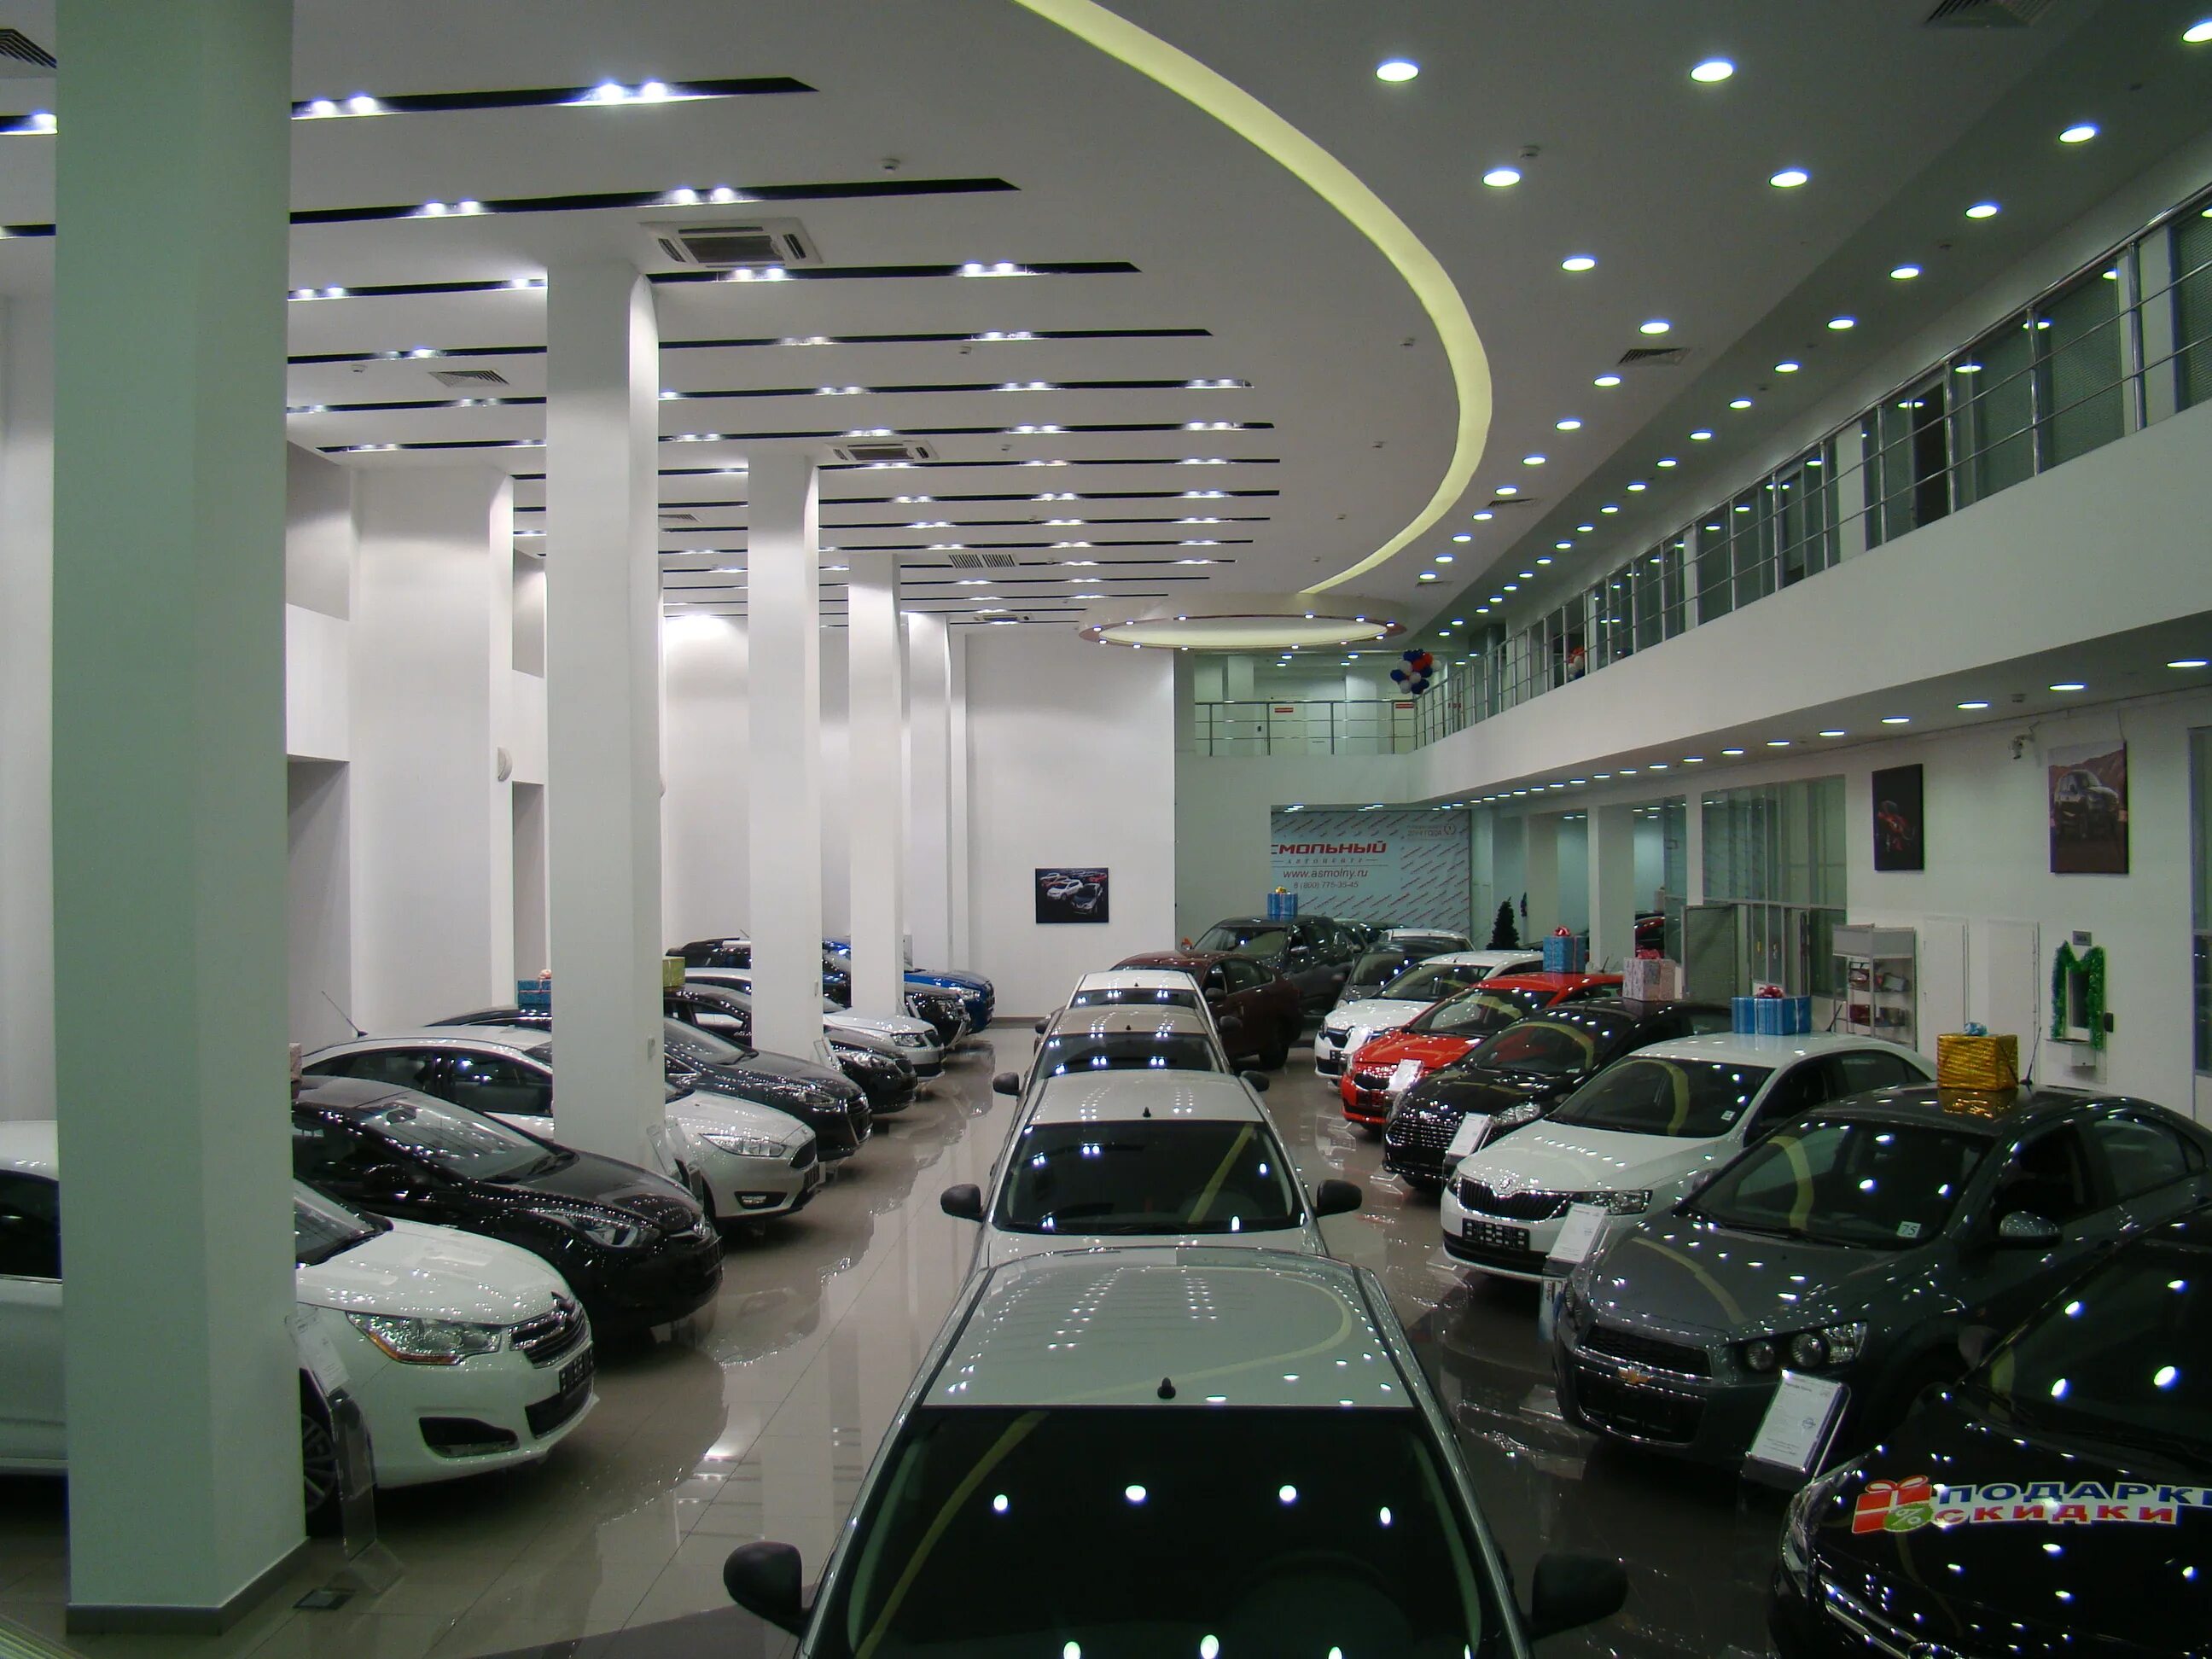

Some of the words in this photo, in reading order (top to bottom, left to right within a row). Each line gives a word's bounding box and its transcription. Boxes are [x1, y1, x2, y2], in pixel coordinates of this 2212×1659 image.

[1283, 868, 1368, 880] www.asmolny.ru
[1901, 1224, 1918, 1236] 75
[1934, 1505, 2174, 1522] СКИДКИ
